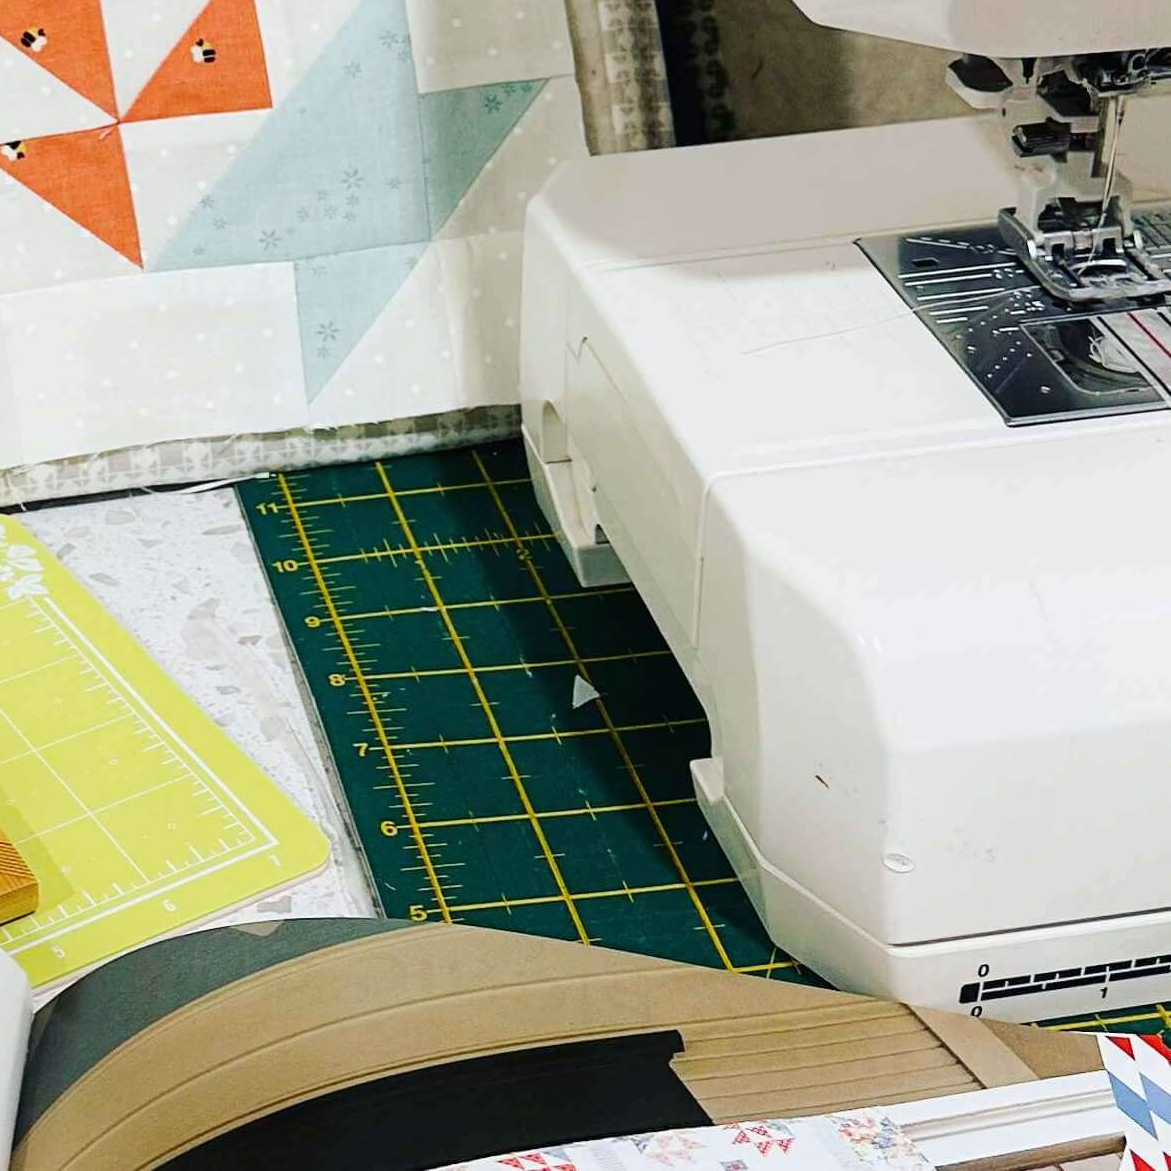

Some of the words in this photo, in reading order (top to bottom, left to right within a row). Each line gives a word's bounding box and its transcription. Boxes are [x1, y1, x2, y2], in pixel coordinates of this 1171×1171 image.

[255, 502, 279, 516] 11
[272, 559, 299, 573] 10
[304, 616, 321, 628] 9
[328, 673, 346, 687] 8
[352, 742, 369, 757] 7
[380, 820, 398, 837] 6
[408, 904, 428, 922] 5
[977, 963, 990, 978] 0
[1099, 986, 1109, 999] 1
